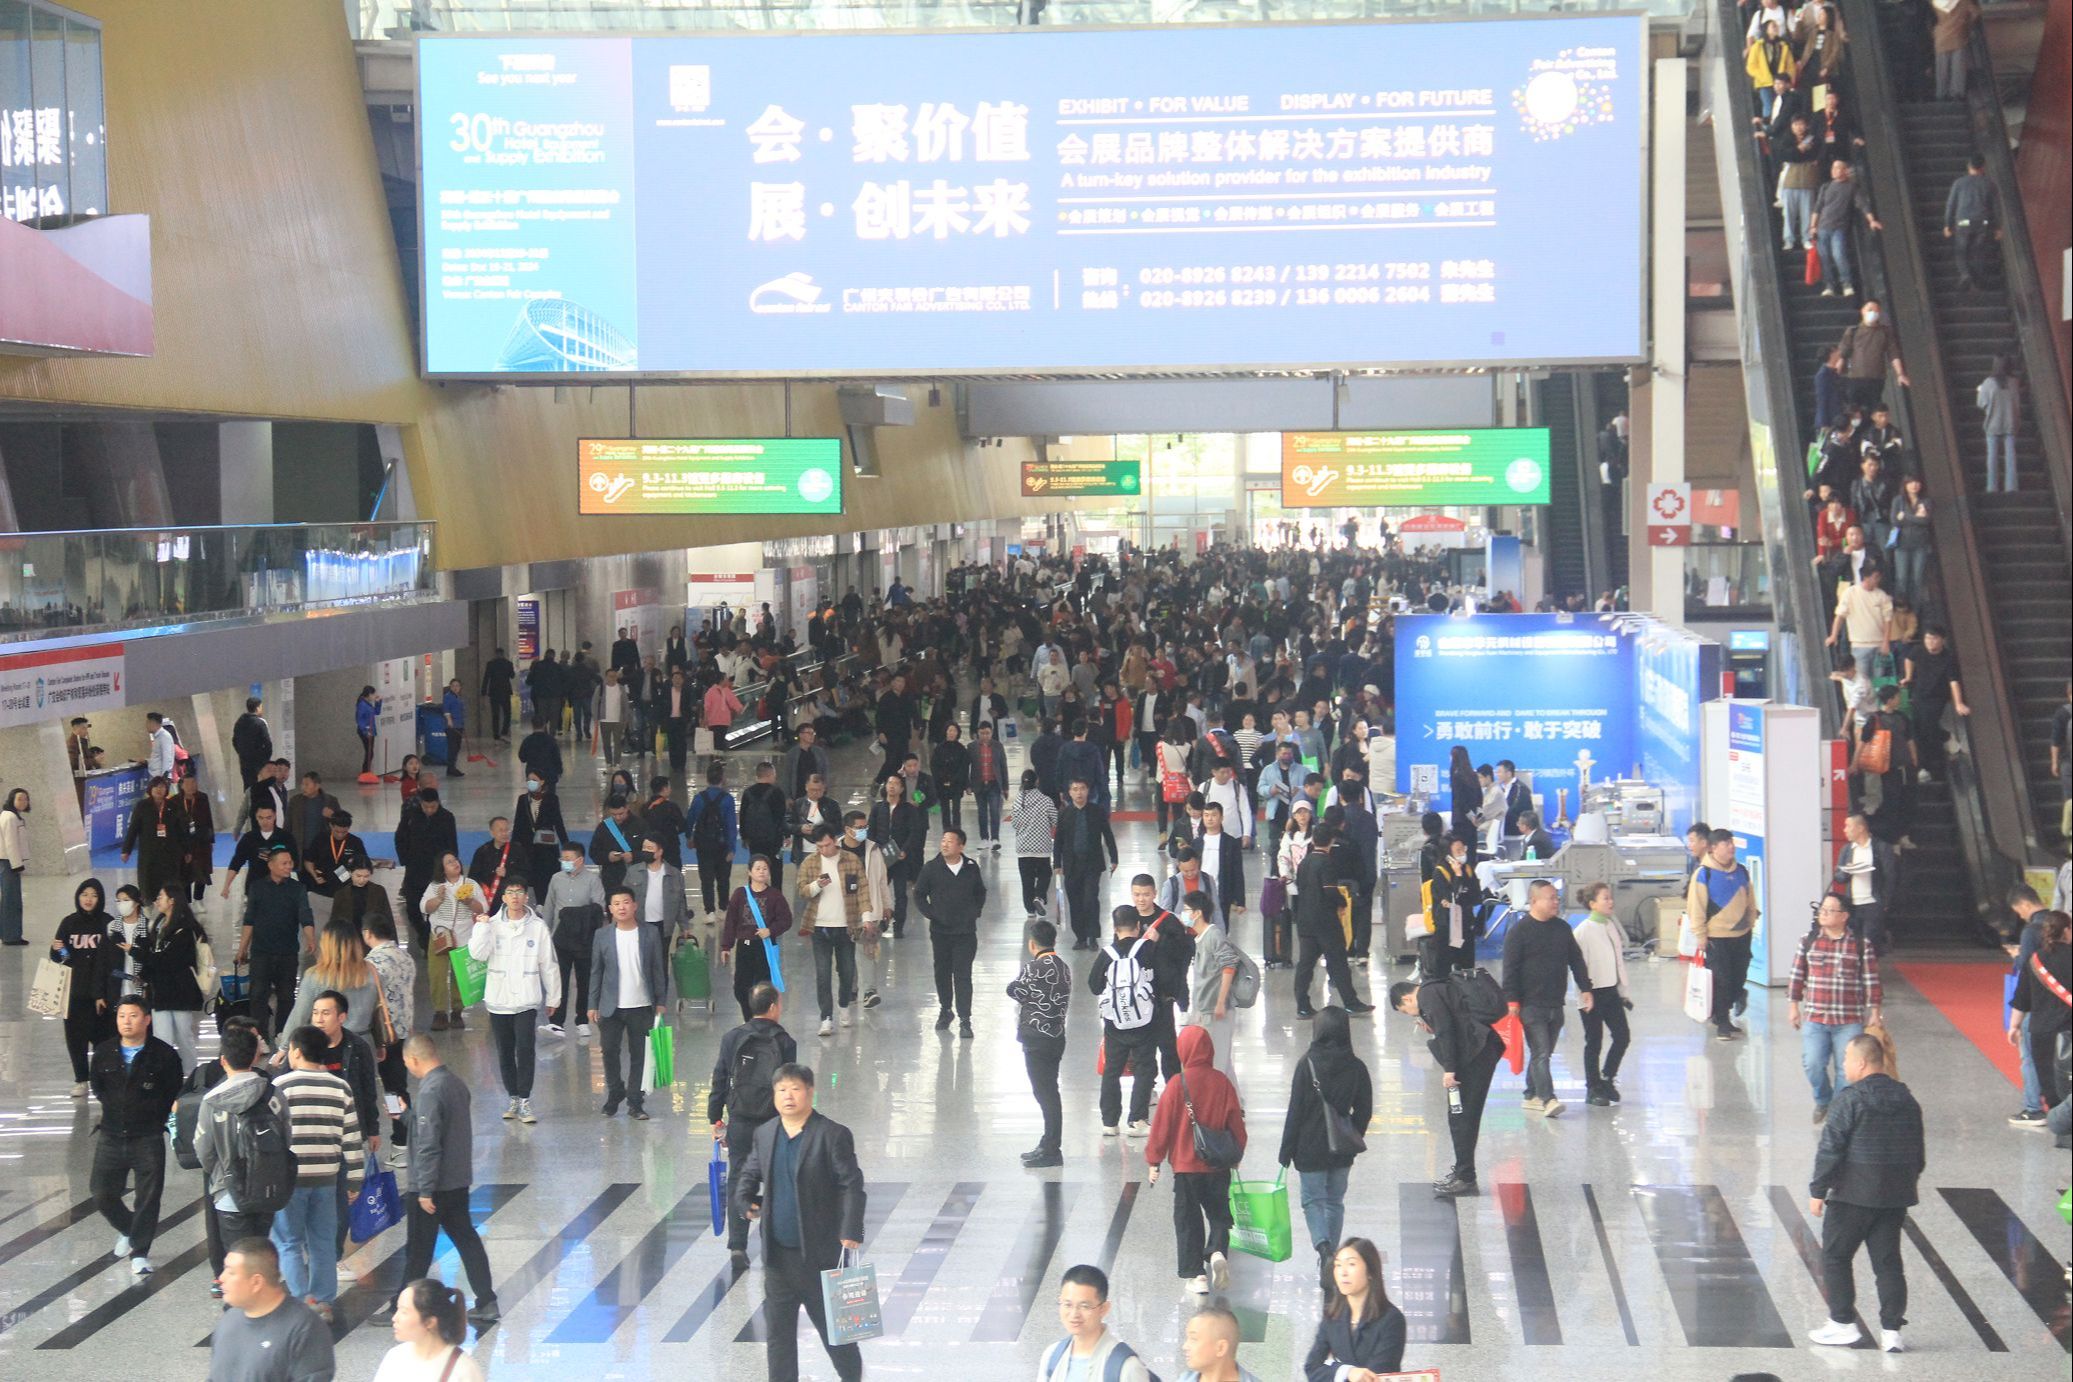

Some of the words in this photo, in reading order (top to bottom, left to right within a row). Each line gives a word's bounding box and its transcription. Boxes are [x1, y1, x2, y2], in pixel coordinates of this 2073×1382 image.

[477, 72, 499, 84] See
[500, 74, 523, 86] you
[552, 73, 578, 86] year
[1058, 98, 1127, 116] EXHIBIT
[1149, 97, 1187, 113] FOR
[1190, 96, 1249, 113] VALUE
[1280, 93, 1356, 111] DISPLAY
[1375, 91, 1415, 108] FOR
[1419, 89, 1492, 106] FUTURE
[512, 120, 604, 140] Guangzhou
[1056, 124, 1494, 165] 会展品牌整体解决方案提供商
[1061, 173, 1074, 188] A
[1077, 172, 1143, 190] turn-key
[1147, 170, 1210, 186] solution
[1215, 169, 1281, 188] provider
[1284, 168, 1307, 184] for
[1310, 167, 1339, 183] the
[1343, 166, 1421, 183] exhibition
[1424, 164, 1492, 184] industry
[1334, 263, 1379, 281] 2214
